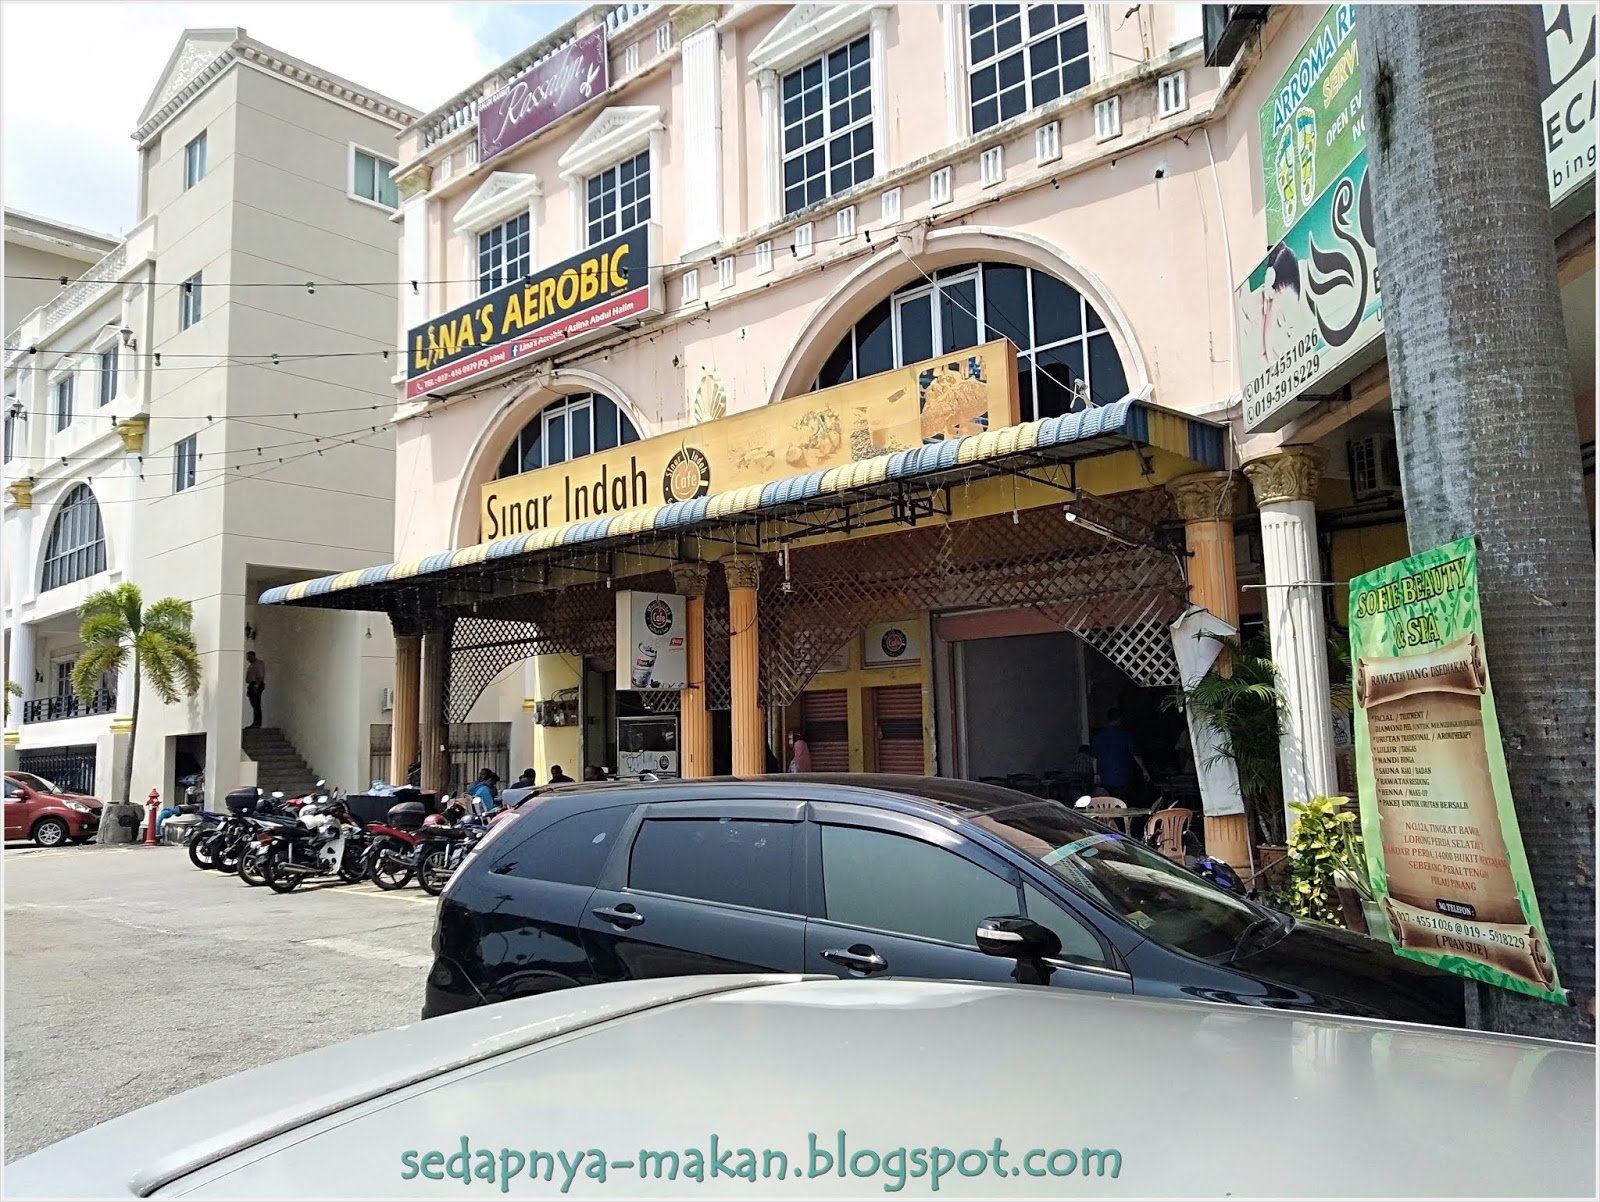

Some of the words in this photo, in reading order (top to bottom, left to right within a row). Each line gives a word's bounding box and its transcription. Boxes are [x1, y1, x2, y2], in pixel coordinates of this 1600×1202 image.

[1272, 24, 1337, 139] ARROMA
[1326, 107, 1349, 147] OPEN
[415, 304, 494, 368] LINA'S
[501, 244, 629, 335] AEROBIC
[519, 340, 538, 352] Lina's
[567, 319, 589, 333] Aslina
[589, 310, 612, 323] Abdul
[612, 302, 635, 316] Halim
[1254, 328, 1318, 394] 017-4551026
[1255, 354, 1320, 417] 019-5918229
[565, 456, 647, 522] Indah
[675, 471, 697, 489] Cafe
[1357, 580, 1401, 619] SOFIE
[1400, 556, 1466, 605] BEAUTY
[1395, 621, 1406, 650] &
[1406, 613, 1441, 647] SPA
[1406, 667, 1428, 681] YANG
[1429, 823, 1458, 835] TINGKAT
[1453, 853, 1479, 864] BUKIT
[1463, 926, 1481, 939] 019
[1488, 929, 1525, 949] 5918229
